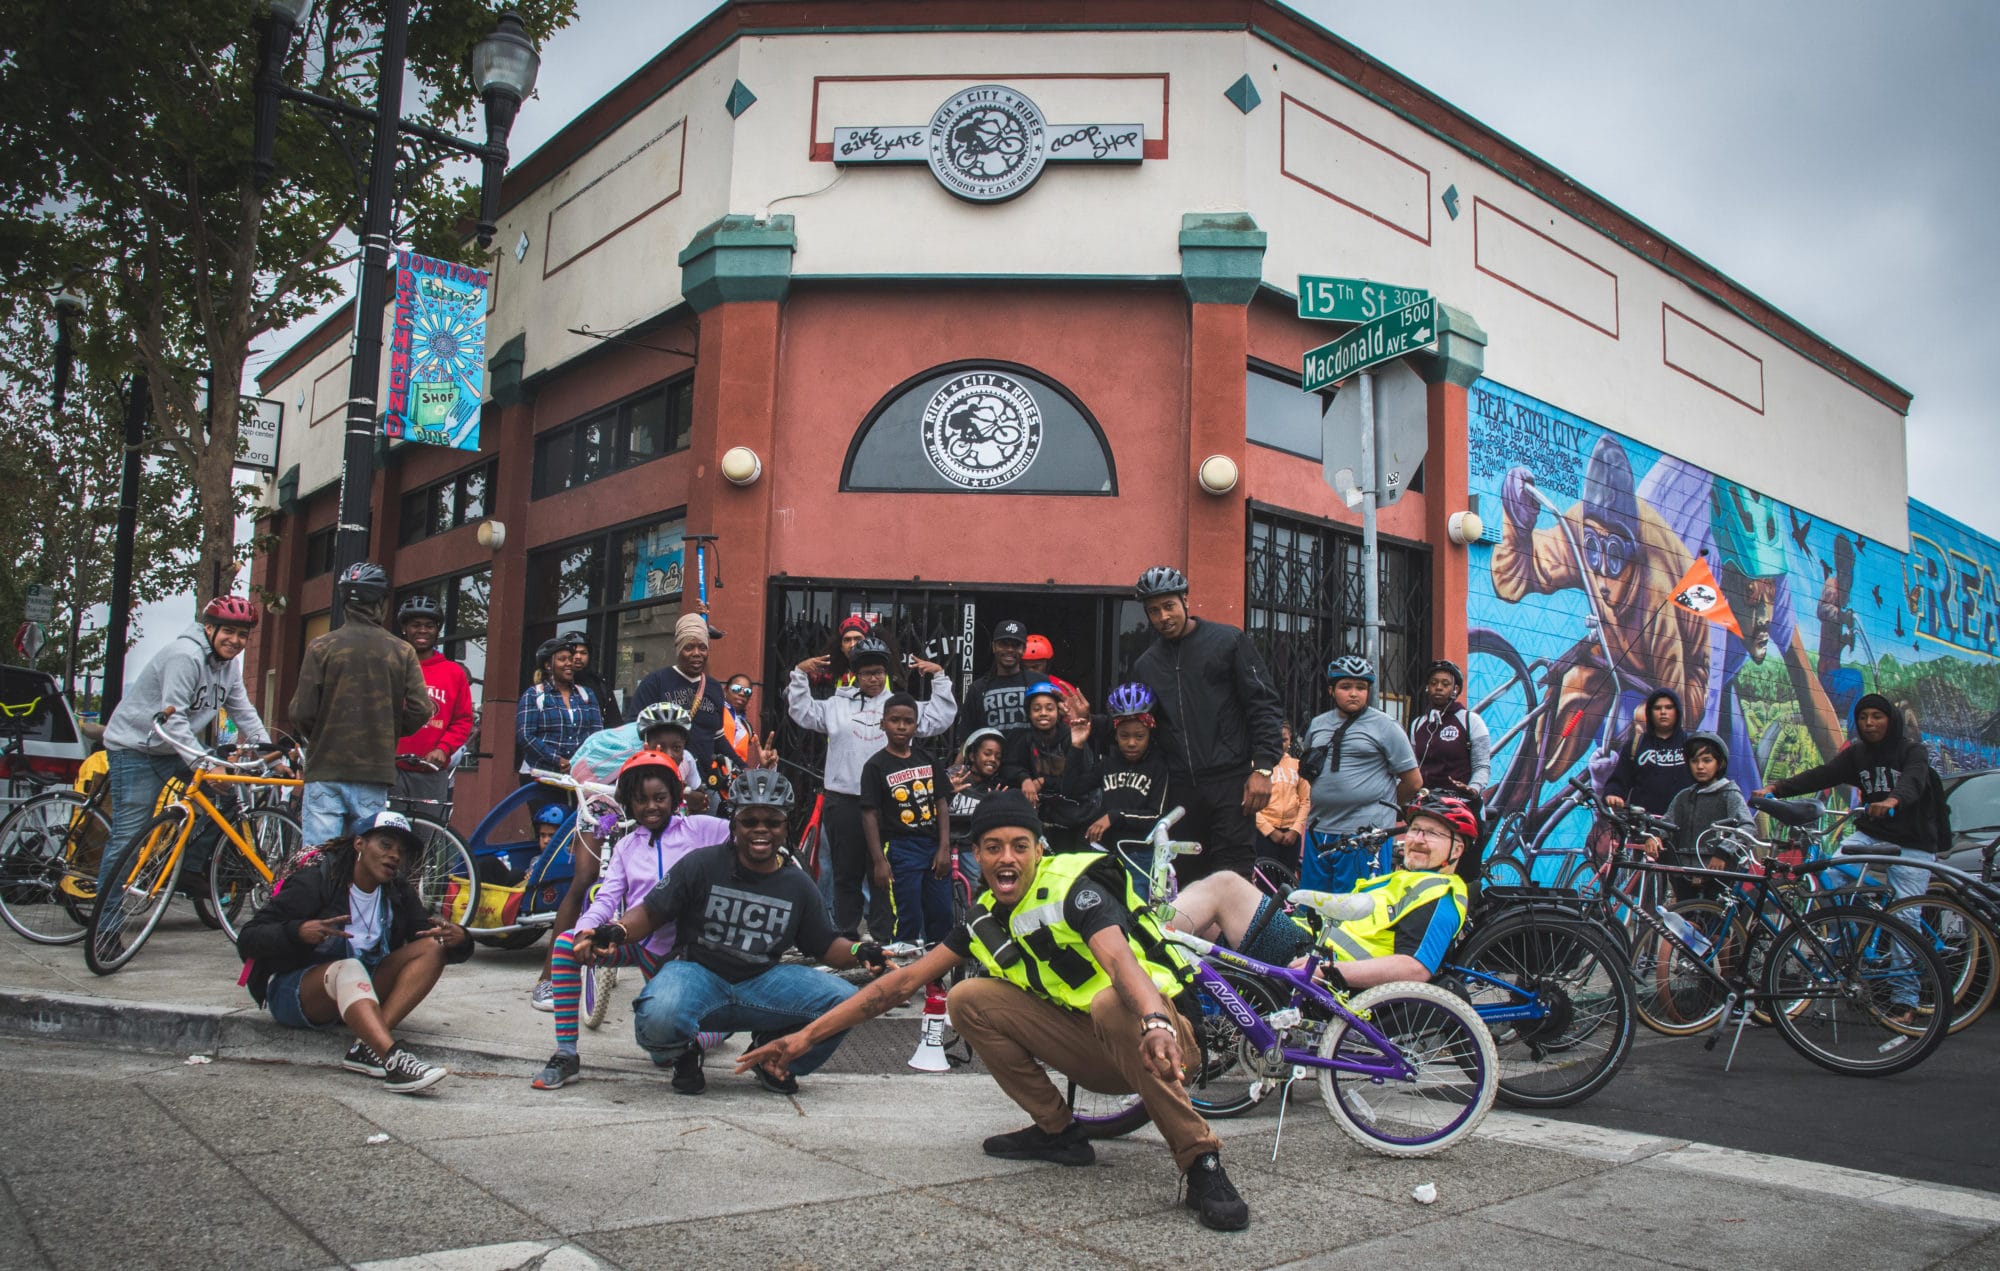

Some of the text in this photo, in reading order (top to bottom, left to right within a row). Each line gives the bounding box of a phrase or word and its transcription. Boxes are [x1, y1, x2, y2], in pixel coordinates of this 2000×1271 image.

[931, 90, 1043, 137] RICH CITY RIDES
[841, 126, 883, 156] BIKE
[873, 131, 924, 160] SKATE
[1092, 132, 1138, 159] SHOP
[935, 157, 1038, 193] RICHMOND CALIFORNIA
[397, 249, 488, 289] DOWNTOWN
[1361, 286, 1387, 318] St
[1394, 289, 1421, 305] 300
[1400, 302, 1430, 327] 1500
[386, 269, 416, 439] RICHMOND
[1306, 323, 1409, 387] Macdonald AVE
[422, 393, 454, 404] SHOP
[925, 375, 1039, 426] RICH CITY RIDES
[412, 425, 451, 446] DINE
[928, 445, 1035, 487] RICHMOND CALIFORNIA
[924, 636, 965, 660] CIT
[963, 605, 975, 671] 1500A
[427, 687, 447, 704] ALL
[987, 706, 1026, 727] CITY
[704, 894, 791, 934] RICH
[703, 921, 783, 953] CITY
[1204, 981, 1255, 1027] AVIGO
